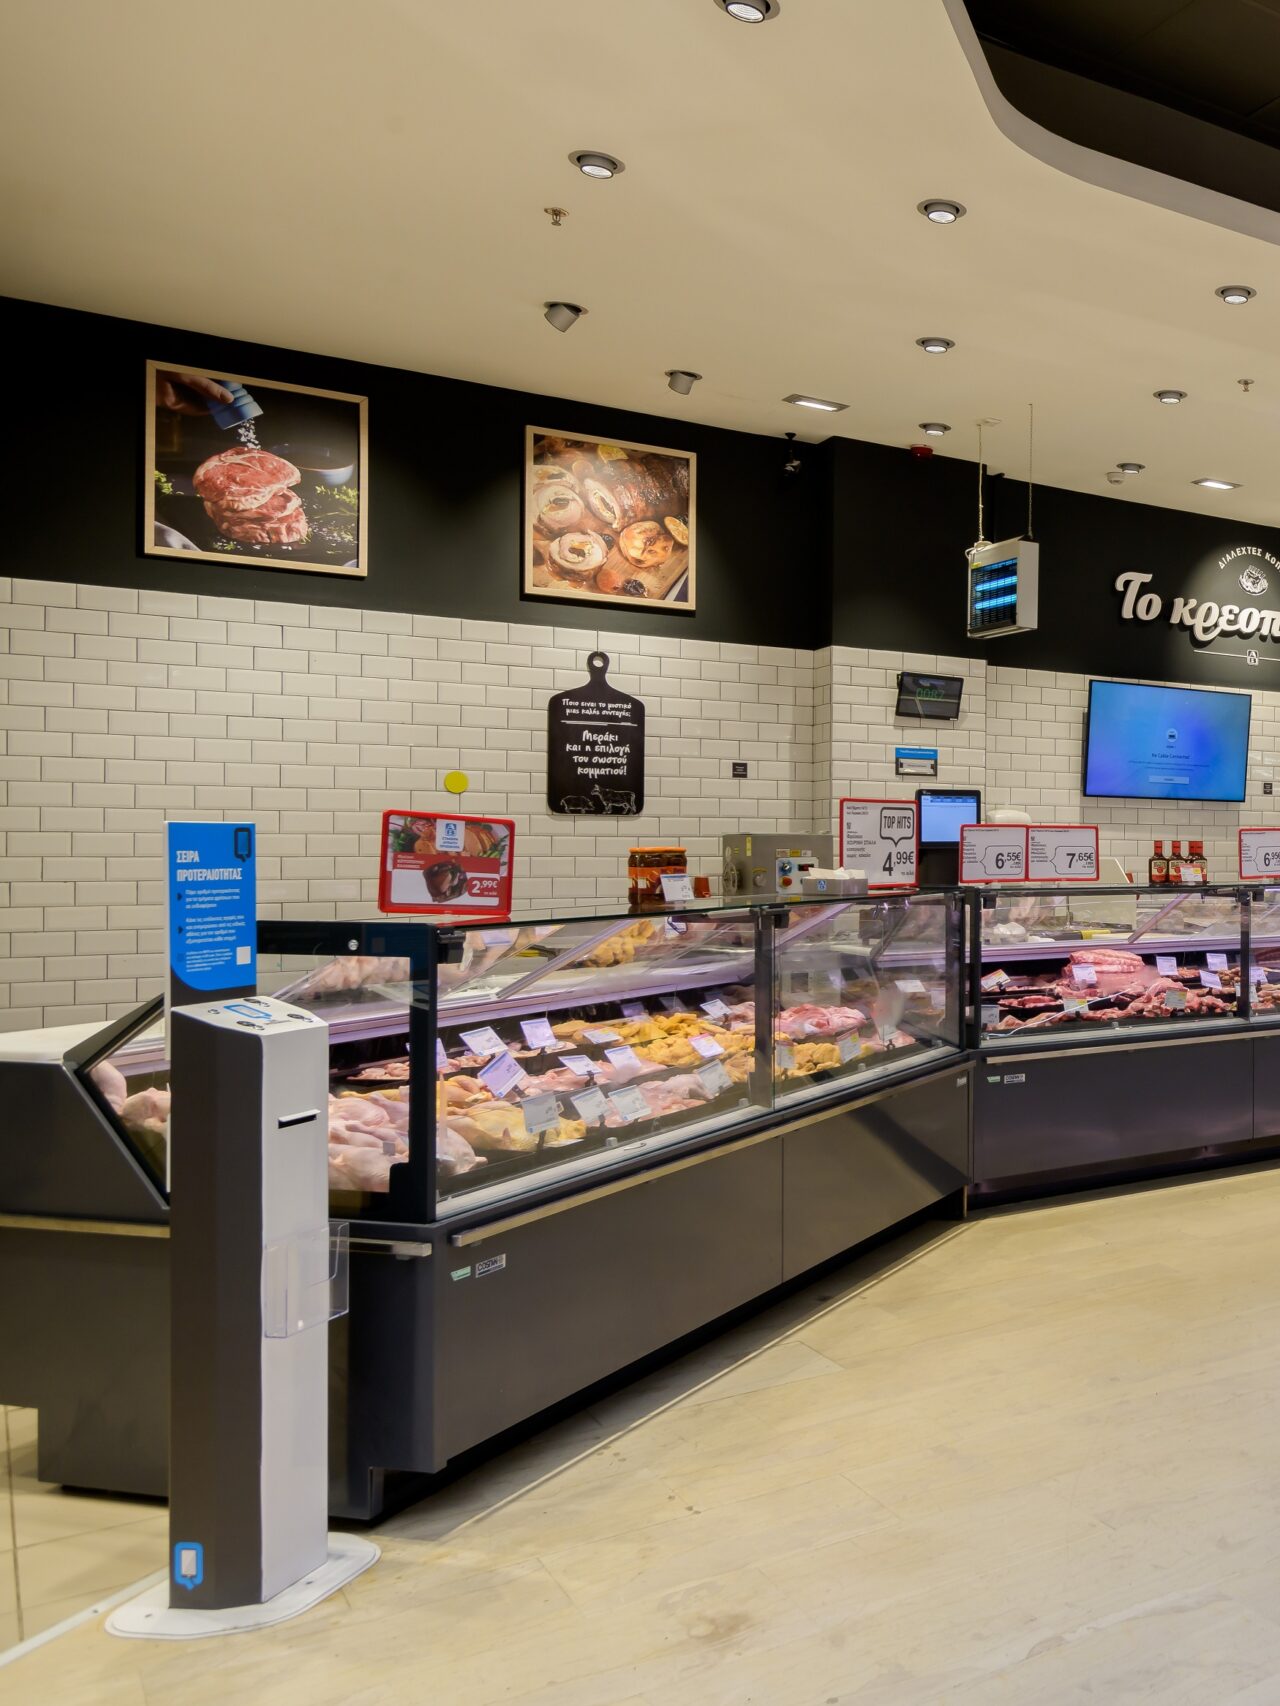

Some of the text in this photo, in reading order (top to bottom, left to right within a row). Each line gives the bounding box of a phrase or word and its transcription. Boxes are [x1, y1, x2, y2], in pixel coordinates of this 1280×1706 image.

[1218, 546, 1262, 569] ΔΙΑΛΕΧΤΕΣ
[1115, 571, 1162, 621] Το
[582, 730, 618, 744] Μεράκι
[566, 743, 581, 752] και
[594, 744, 630, 755] επιλογή
[572, 754, 627, 764] του σωστού
[577, 765, 627, 778] κομματιού!
[883, 816, 912, 829] TOP HITS
[176, 850, 200, 863] ΣΕΙΡΑ
[882, 851, 914, 876] 4,99€
[995, 852, 1021, 869] 6,55€
[1066, 852, 1094, 869] 7,65€
[176, 868, 242, 882] ΠΡΟΤΕΡΑΙΟΤΗΤΑΣ
